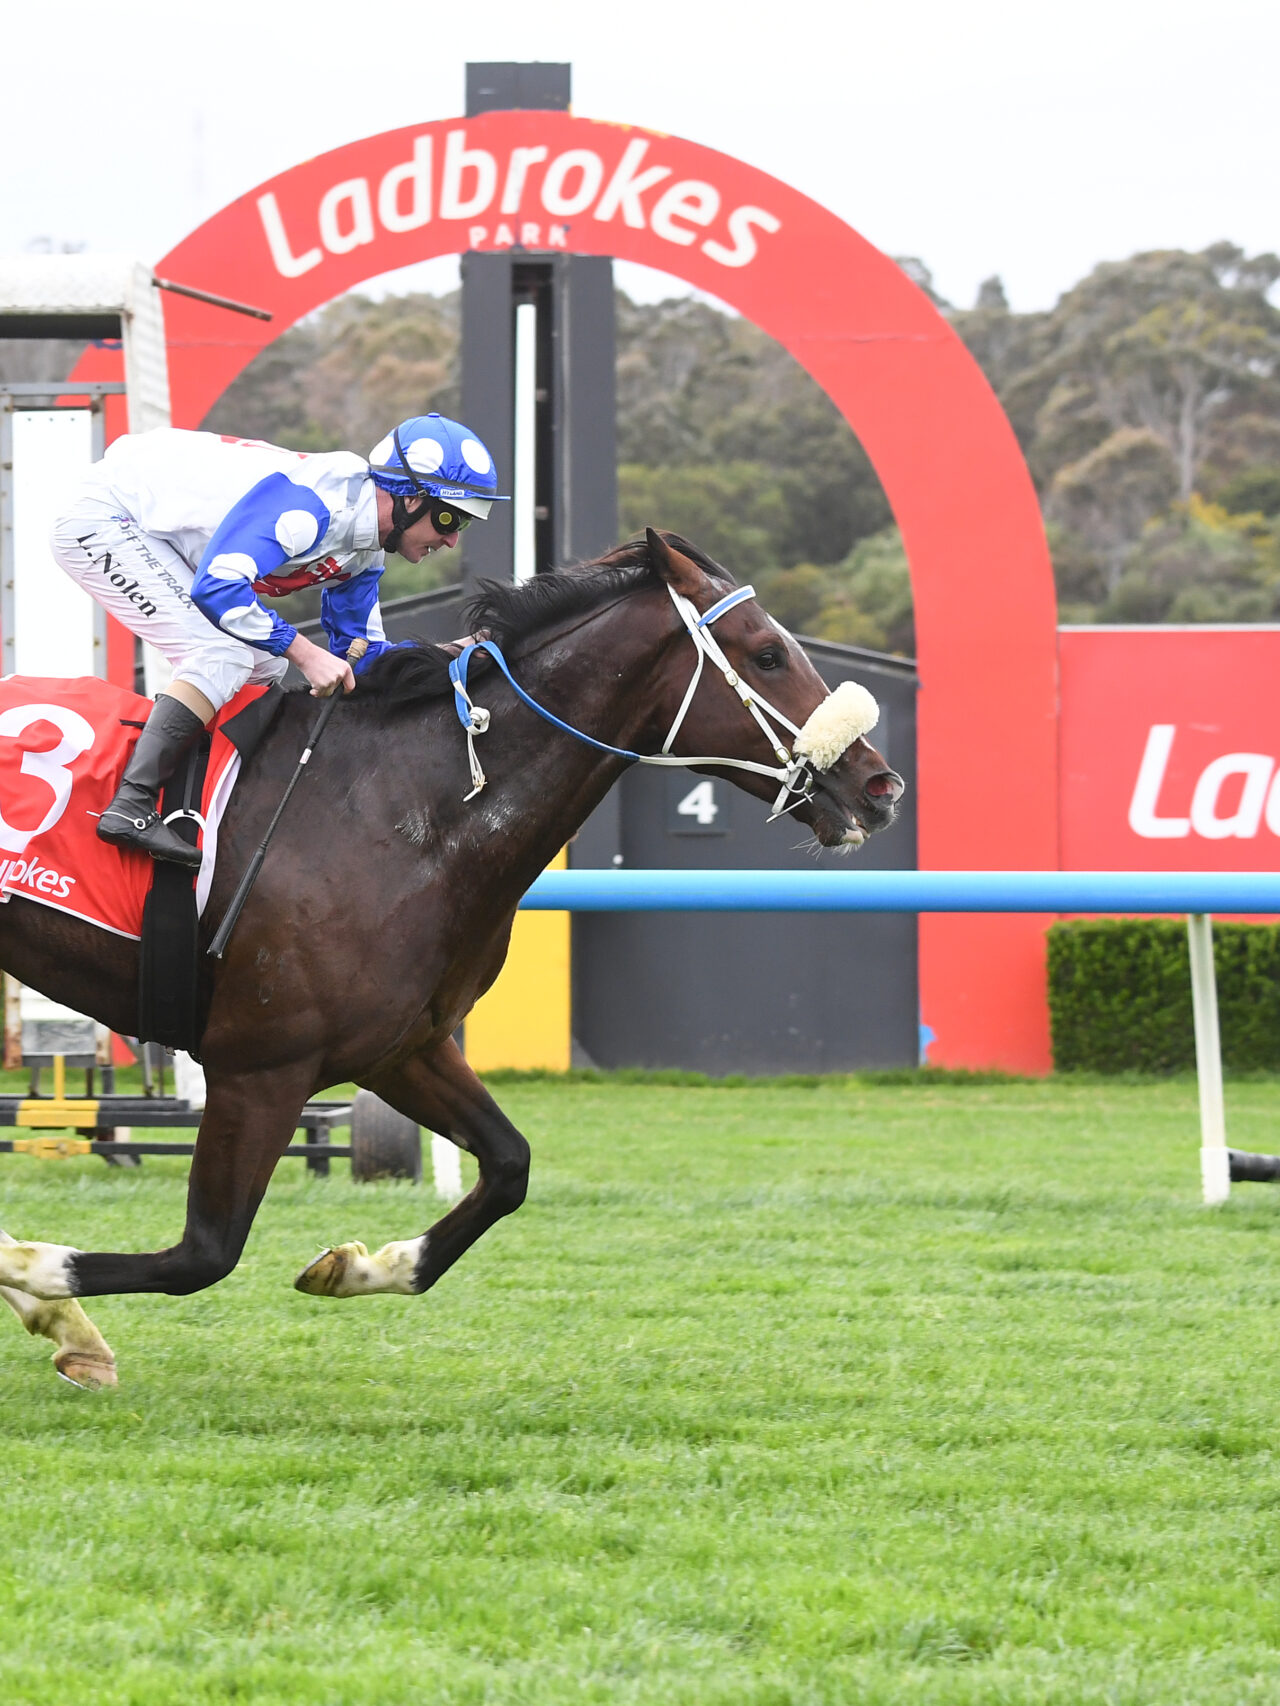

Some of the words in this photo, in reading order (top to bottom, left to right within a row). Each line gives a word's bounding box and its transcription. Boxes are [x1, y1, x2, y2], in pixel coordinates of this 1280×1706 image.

[257, 130, 781, 278] Ladbrokes
[468, 222, 567, 248] PARK
[119, 522, 141, 543] OFF
[136, 544, 163, 570] THE
[157, 569, 195, 609] TRACK
[677, 781, 718, 824] 4
[1128, 724, 1280, 839] La
